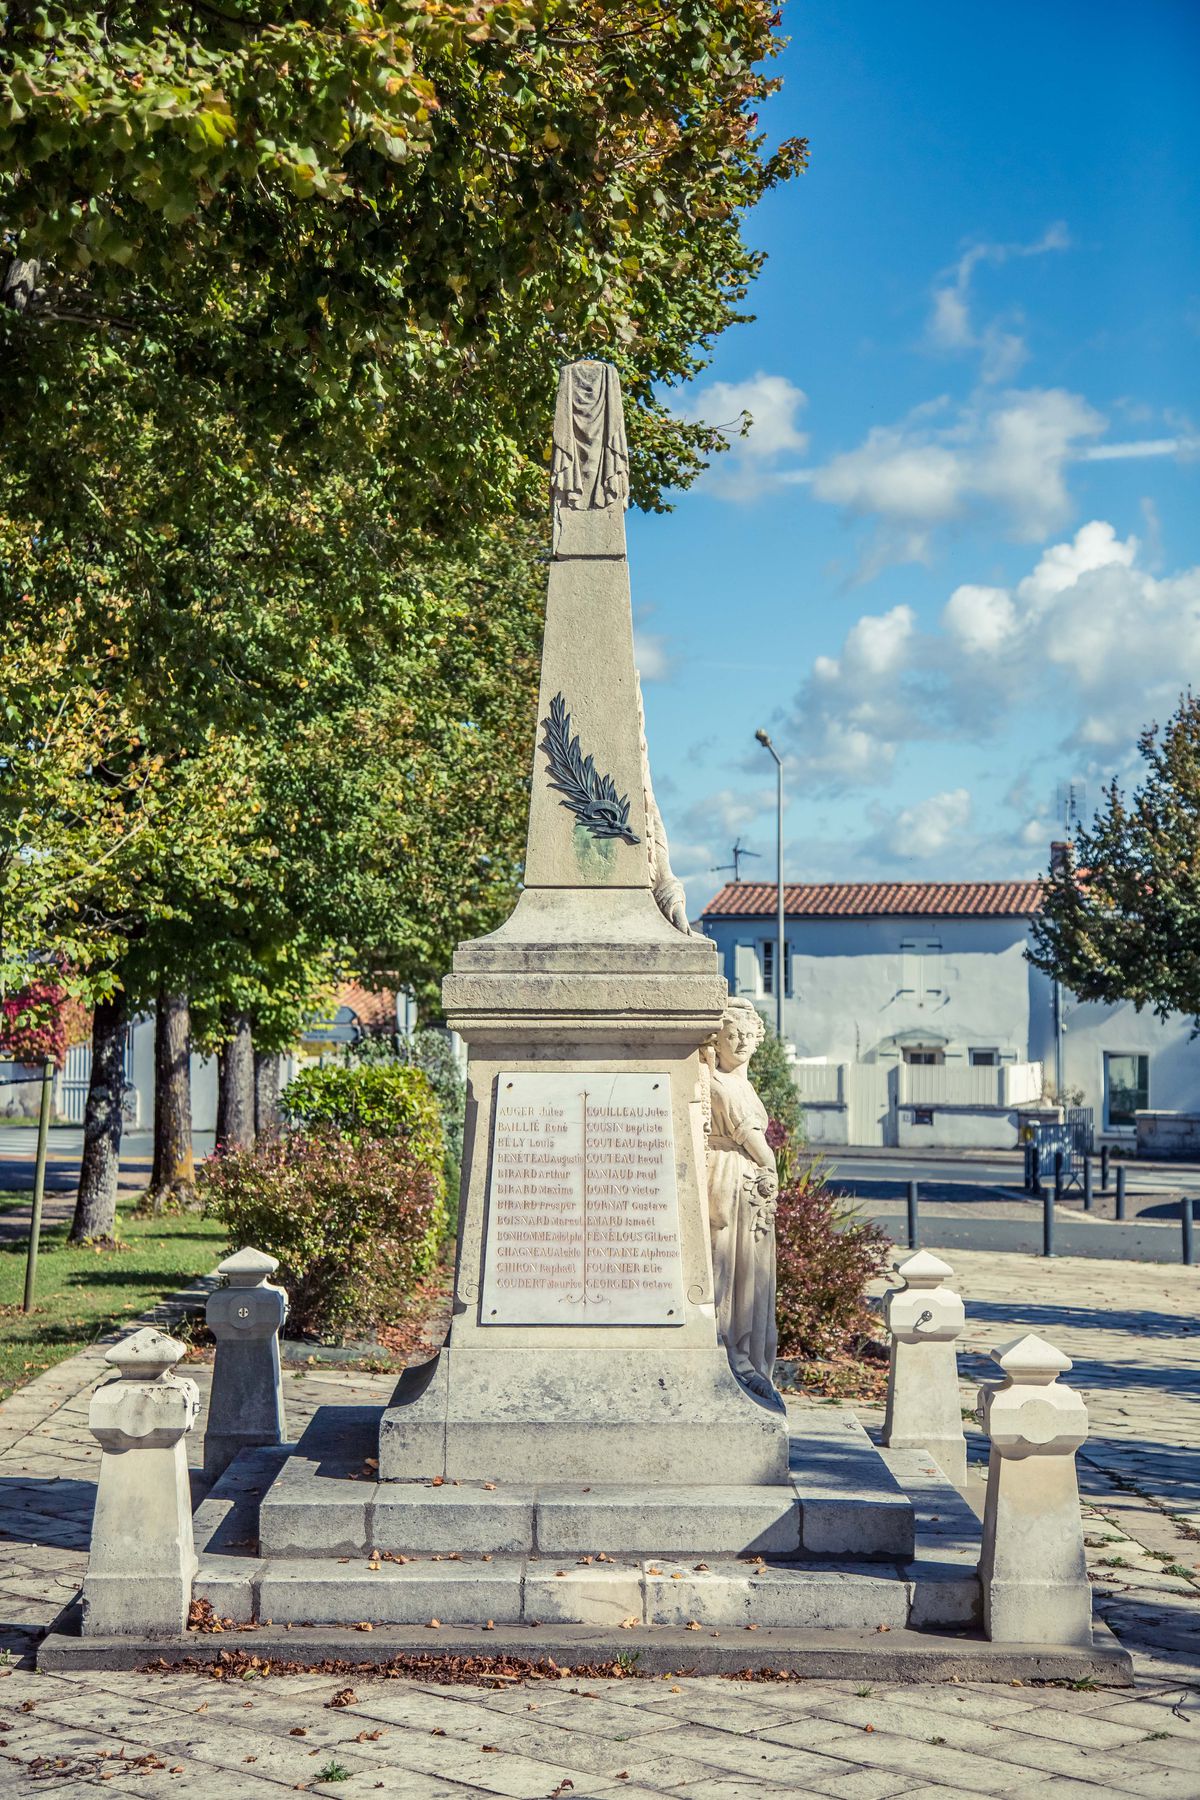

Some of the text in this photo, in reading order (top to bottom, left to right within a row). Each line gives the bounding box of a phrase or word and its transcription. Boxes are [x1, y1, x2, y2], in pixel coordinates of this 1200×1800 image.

[500, 1106, 564, 1117] AUGER Jules
[587, 1106, 669, 1117] COUILLEAU Jules
[498, 1119, 568, 1133] BAILLIÉ René
[587, 1122, 663, 1136] COUSIN Baptiste
[529, 1136, 555, 1148] Louis
[587, 1138, 673, 1152] COUTEAU Baptiste
[587, 1153, 663, 1164] COUTEAU Raoul
[498, 1168, 571, 1179] BIRARD Arthur
[587, 1169, 657, 1179] DANIAUD Paul
[497, 1183, 574, 1195] BIRARD Maxime
[587, 1184, 660, 1196] DOMINO Victor
[497, 1200, 577, 1214] BIRARD Prosper
[587, 1200, 668, 1211] DORNAT Gustave
[497, 1216, 583, 1226] BOISNARD Marcel
[497, 1231, 552, 1241] BONHOMME
[644, 1231, 677, 1242] Gilbert
[497, 1247, 554, 1257] CHAGNEAU
[587, 1247, 680, 1261] FONTAINE Alphonse
[497, 1263, 537, 1273] CHIRON
[586, 1263, 640, 1273] FOURNIER
[497, 1278, 583, 1289] COUDERT Maurice
